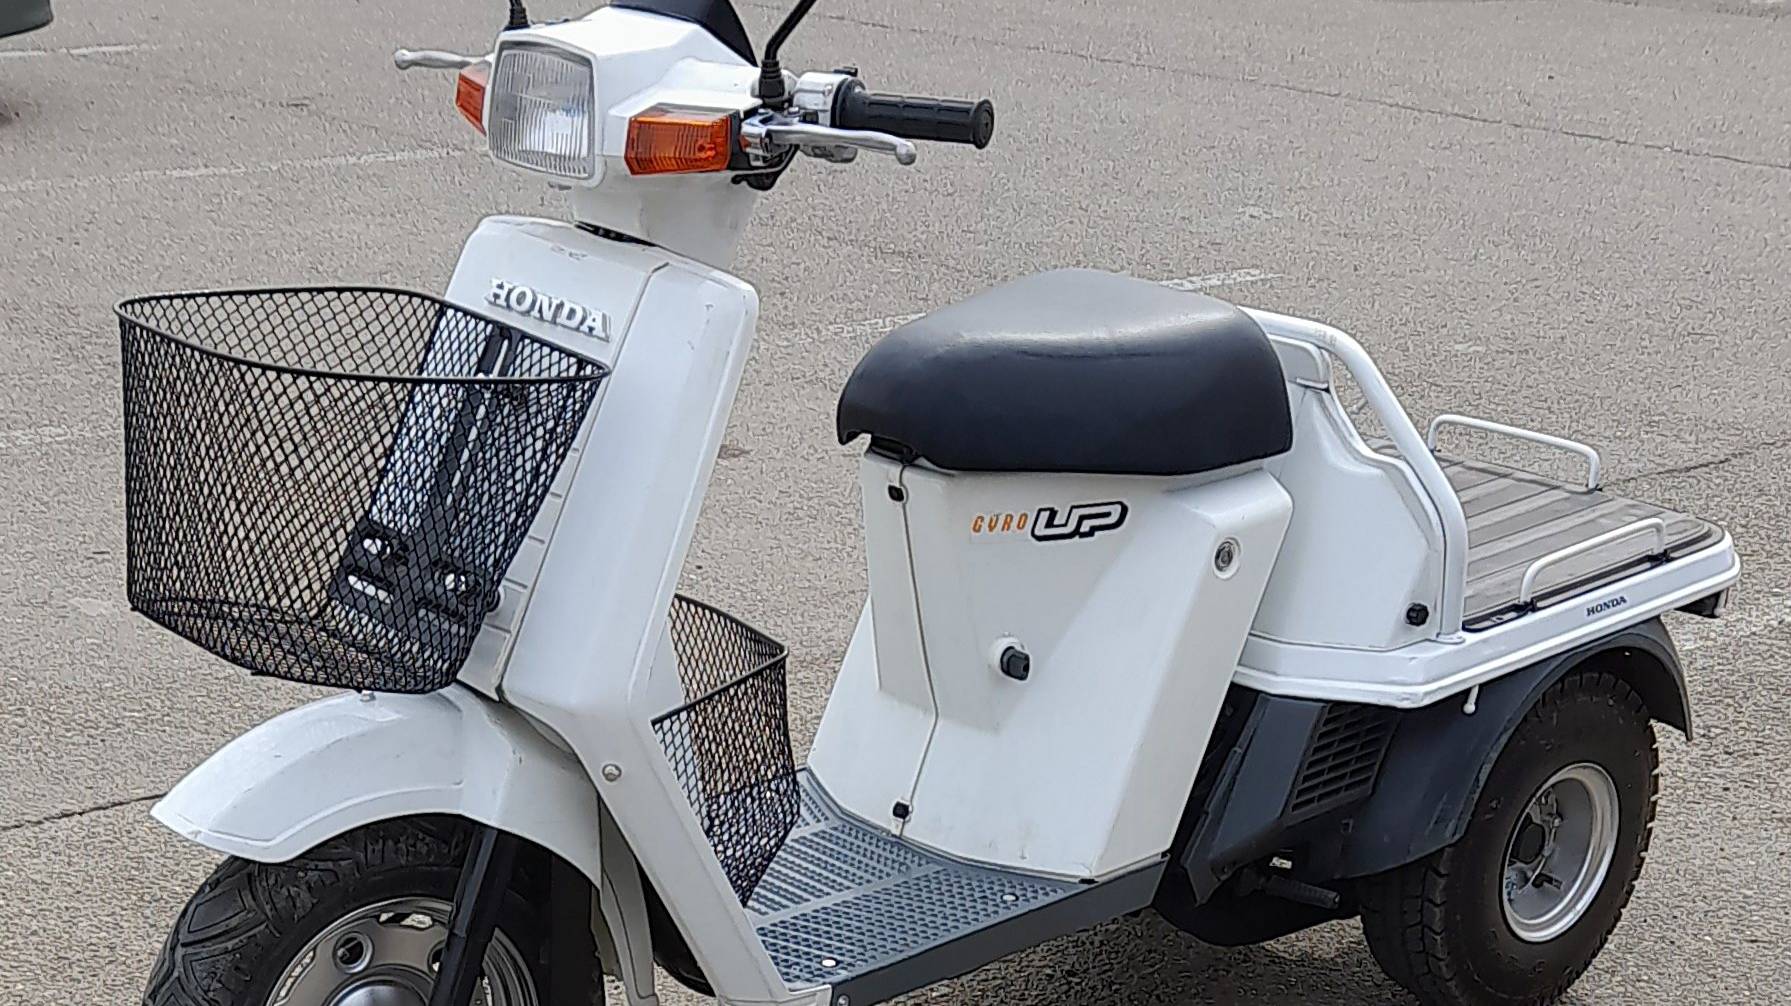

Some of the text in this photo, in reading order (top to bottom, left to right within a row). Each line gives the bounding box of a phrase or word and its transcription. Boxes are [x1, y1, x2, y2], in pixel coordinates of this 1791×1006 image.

[486, 277, 611, 342] HONDA
[1031, 501, 1128, 542] UP
[1586, 596, 1627, 616] HONDA
